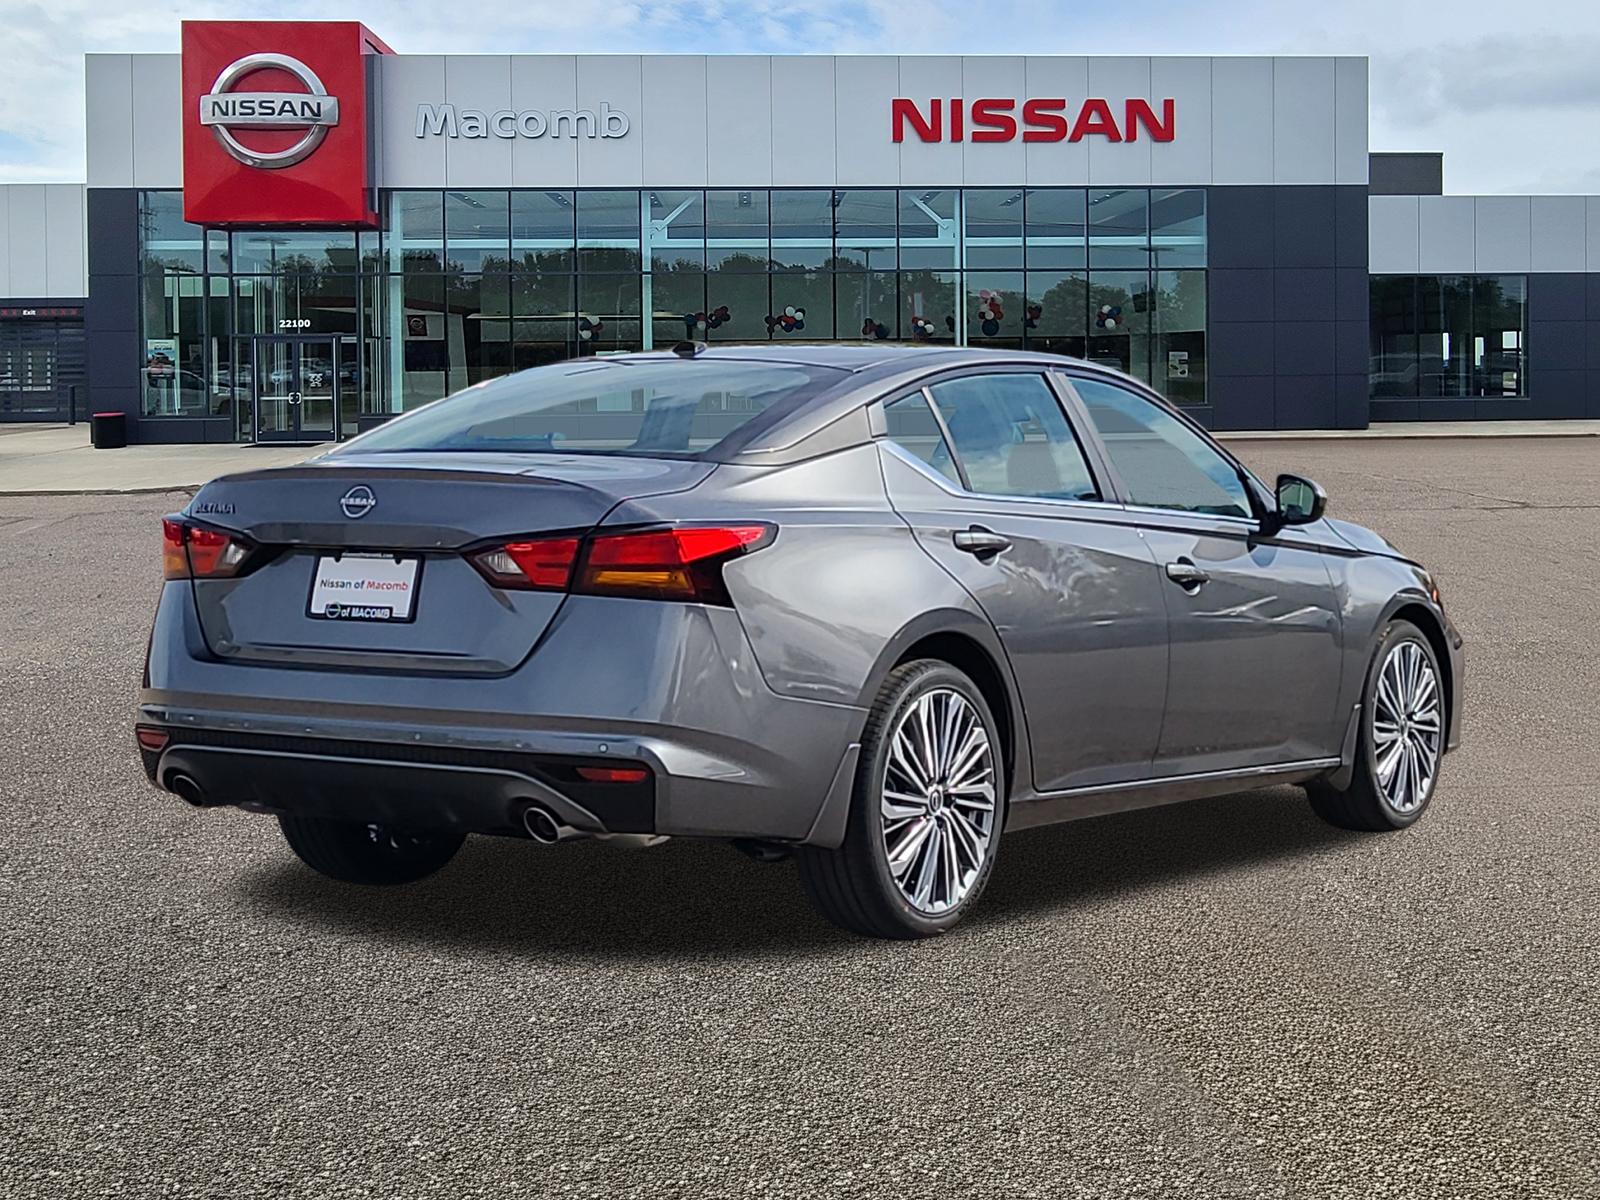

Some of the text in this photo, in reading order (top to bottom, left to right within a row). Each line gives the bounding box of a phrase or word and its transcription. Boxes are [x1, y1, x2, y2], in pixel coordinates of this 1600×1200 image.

[212, 101, 322, 118] NISSAN
[415, 102, 630, 139] Macomb
[892, 98, 1176, 143] NISSAN
[279, 319, 312, 329] 22100
[340, 497, 376, 506] NISSAN
[320, 579, 409, 591] Nissan of Macomb
[341, 607, 391, 619] of MACOMB
